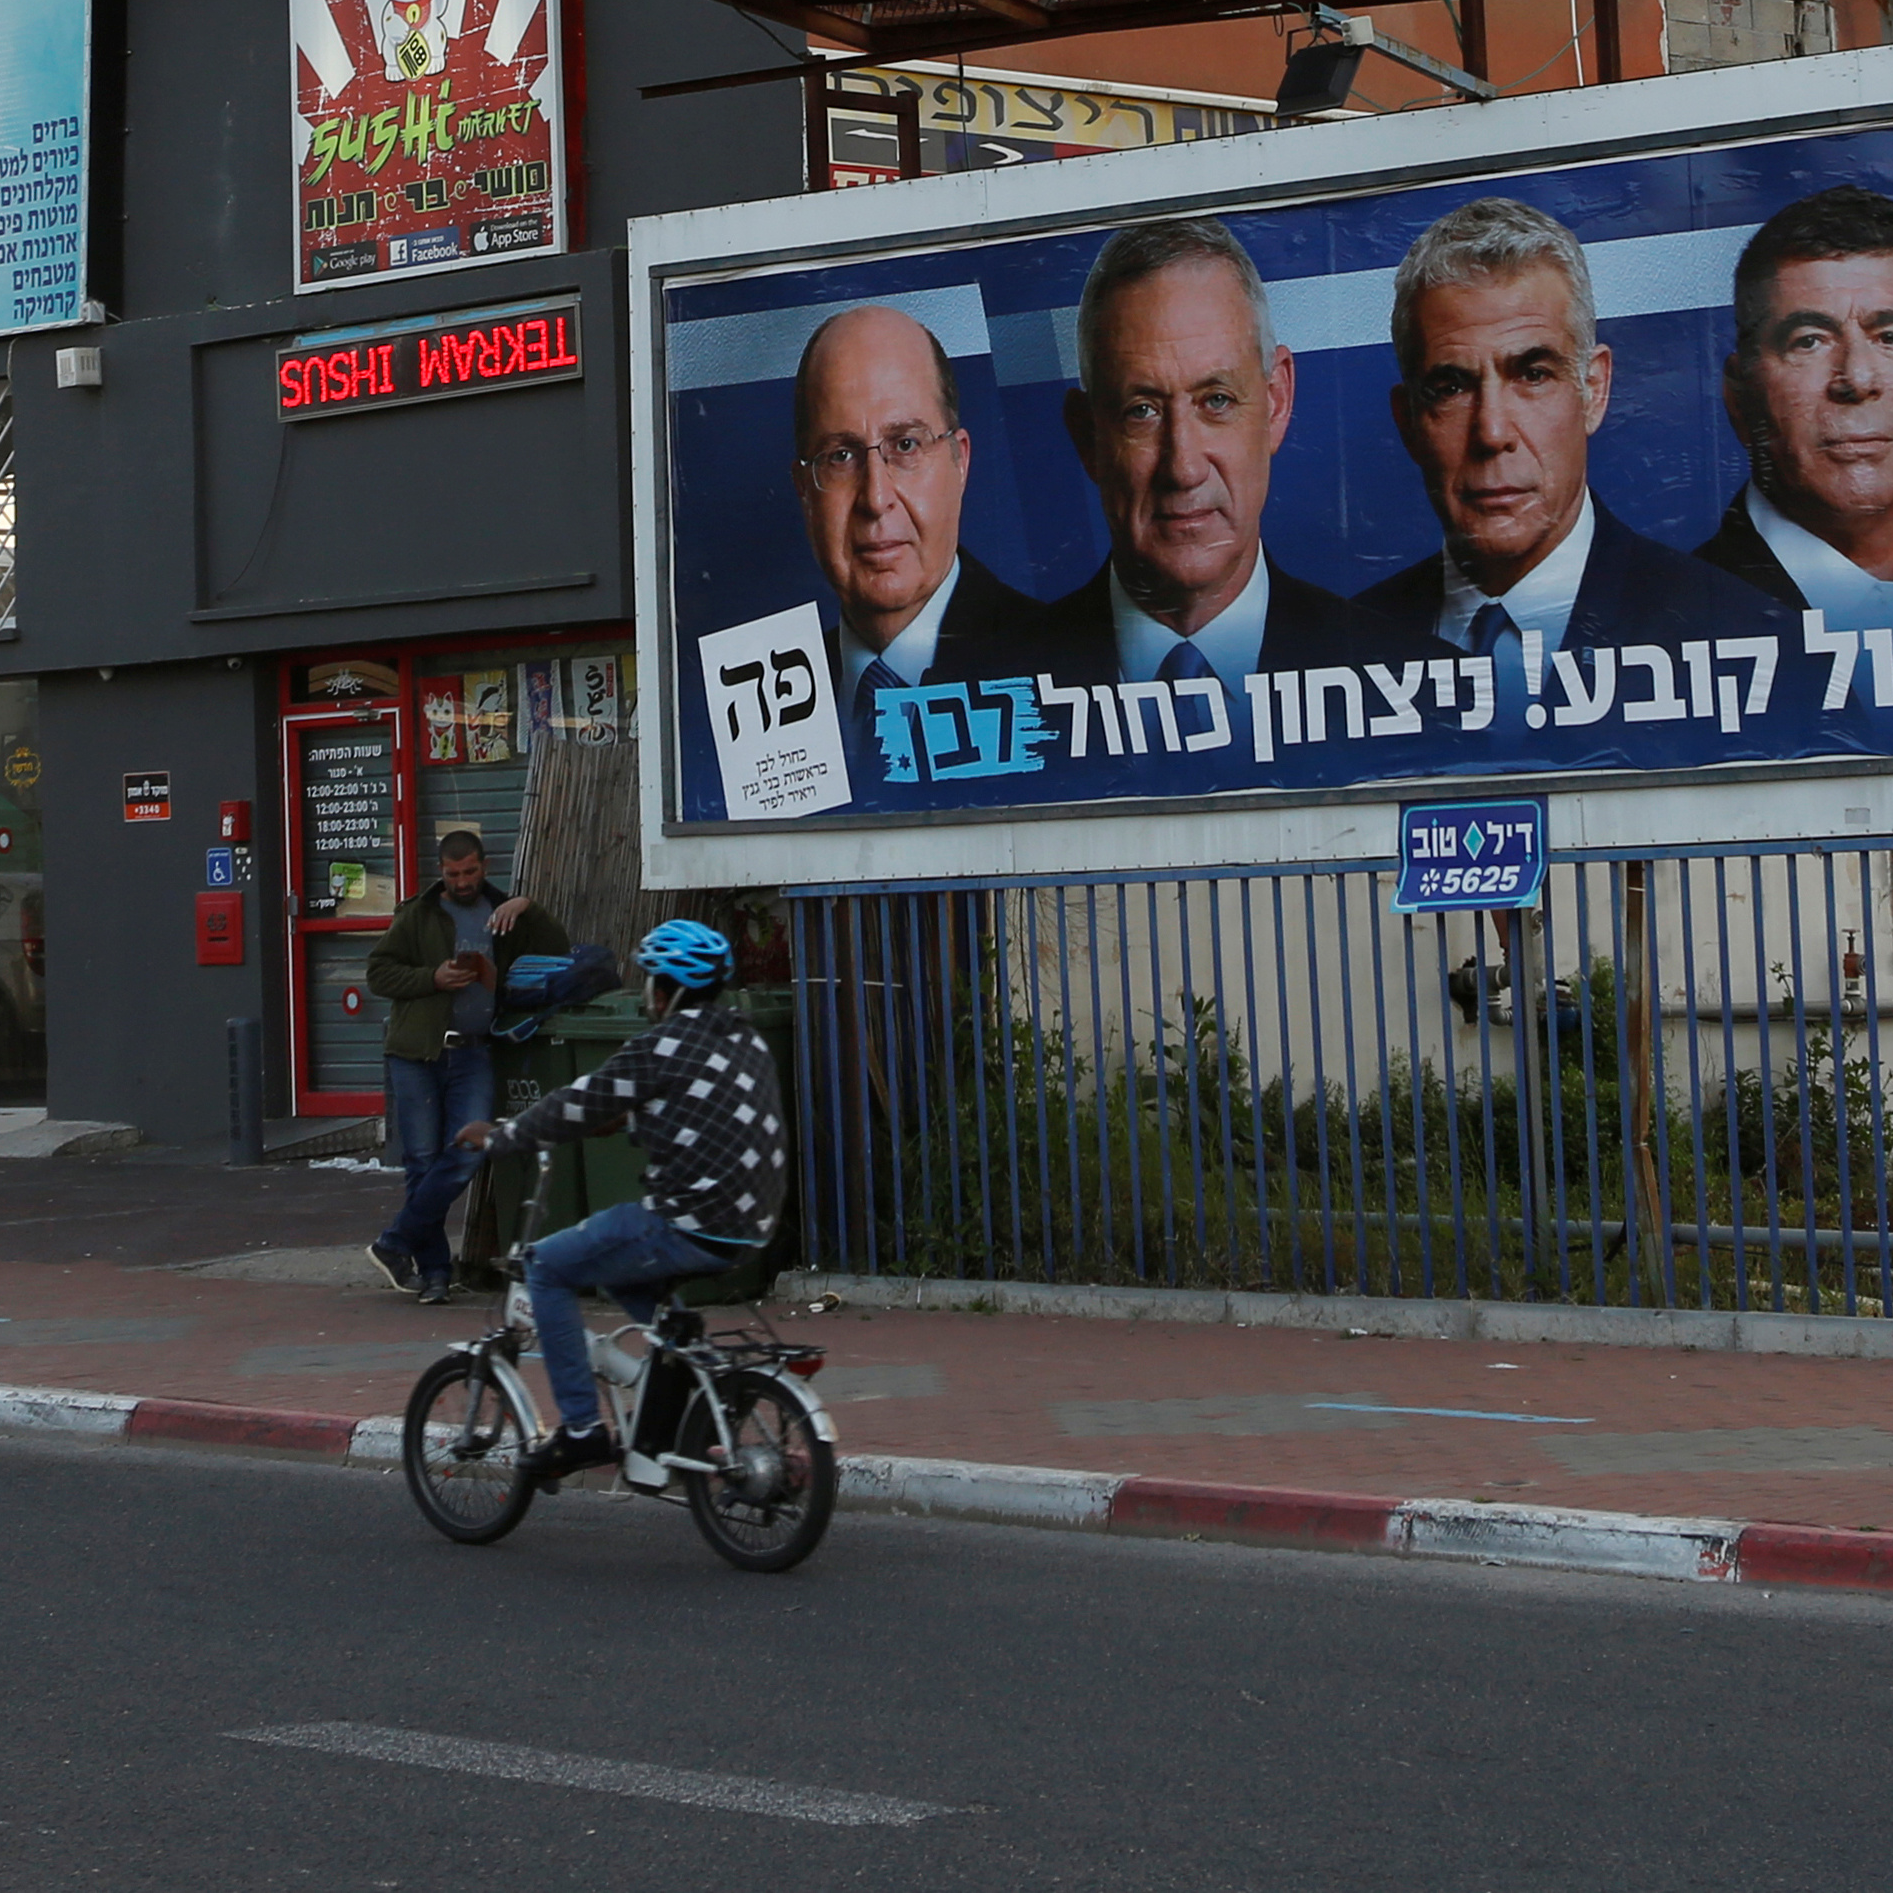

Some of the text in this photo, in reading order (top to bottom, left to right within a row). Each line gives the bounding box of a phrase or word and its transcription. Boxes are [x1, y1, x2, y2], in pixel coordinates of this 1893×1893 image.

[33, 116, 79, 144] ברזים
[33, 145, 79, 172] כיורים
[1, 172, 78, 207] מקלחונים
[304, 160, 548, 232] סושי בר חנות
[27, 203, 78, 231] מוטות
[22, 231, 77, 261] ארונות
[491, 227, 538, 248] App Store
[329, 257, 358, 273] Google
[360, 253, 376, 267] play
[412, 243, 458, 263] Facebook
[13, 261, 76, 291] מטבחים
[14, 290, 76, 324] קרמיקה
[720, 648, 816, 742] פה
[1523, 629, 1779, 734] קובע!
[1036, 673, 1232, 758] כחול
[1243, 654, 1494, 763] ניצחון
[353, 744, 382, 759] שעות
[756, 748, 807, 777] כחול לבן
[306, 784, 358, 798] 12:00-22:00
[742, 762, 828, 800] בראשות בני גנץ
[315, 800, 368, 815] 12:00-23:00
[759, 785, 817, 811] ויאיר לפיד
[317, 818, 370, 833] 18:00-23:00
[1411, 820, 1533, 859] דיל טוב
[315, 836, 368, 850] 12:00-18:00
